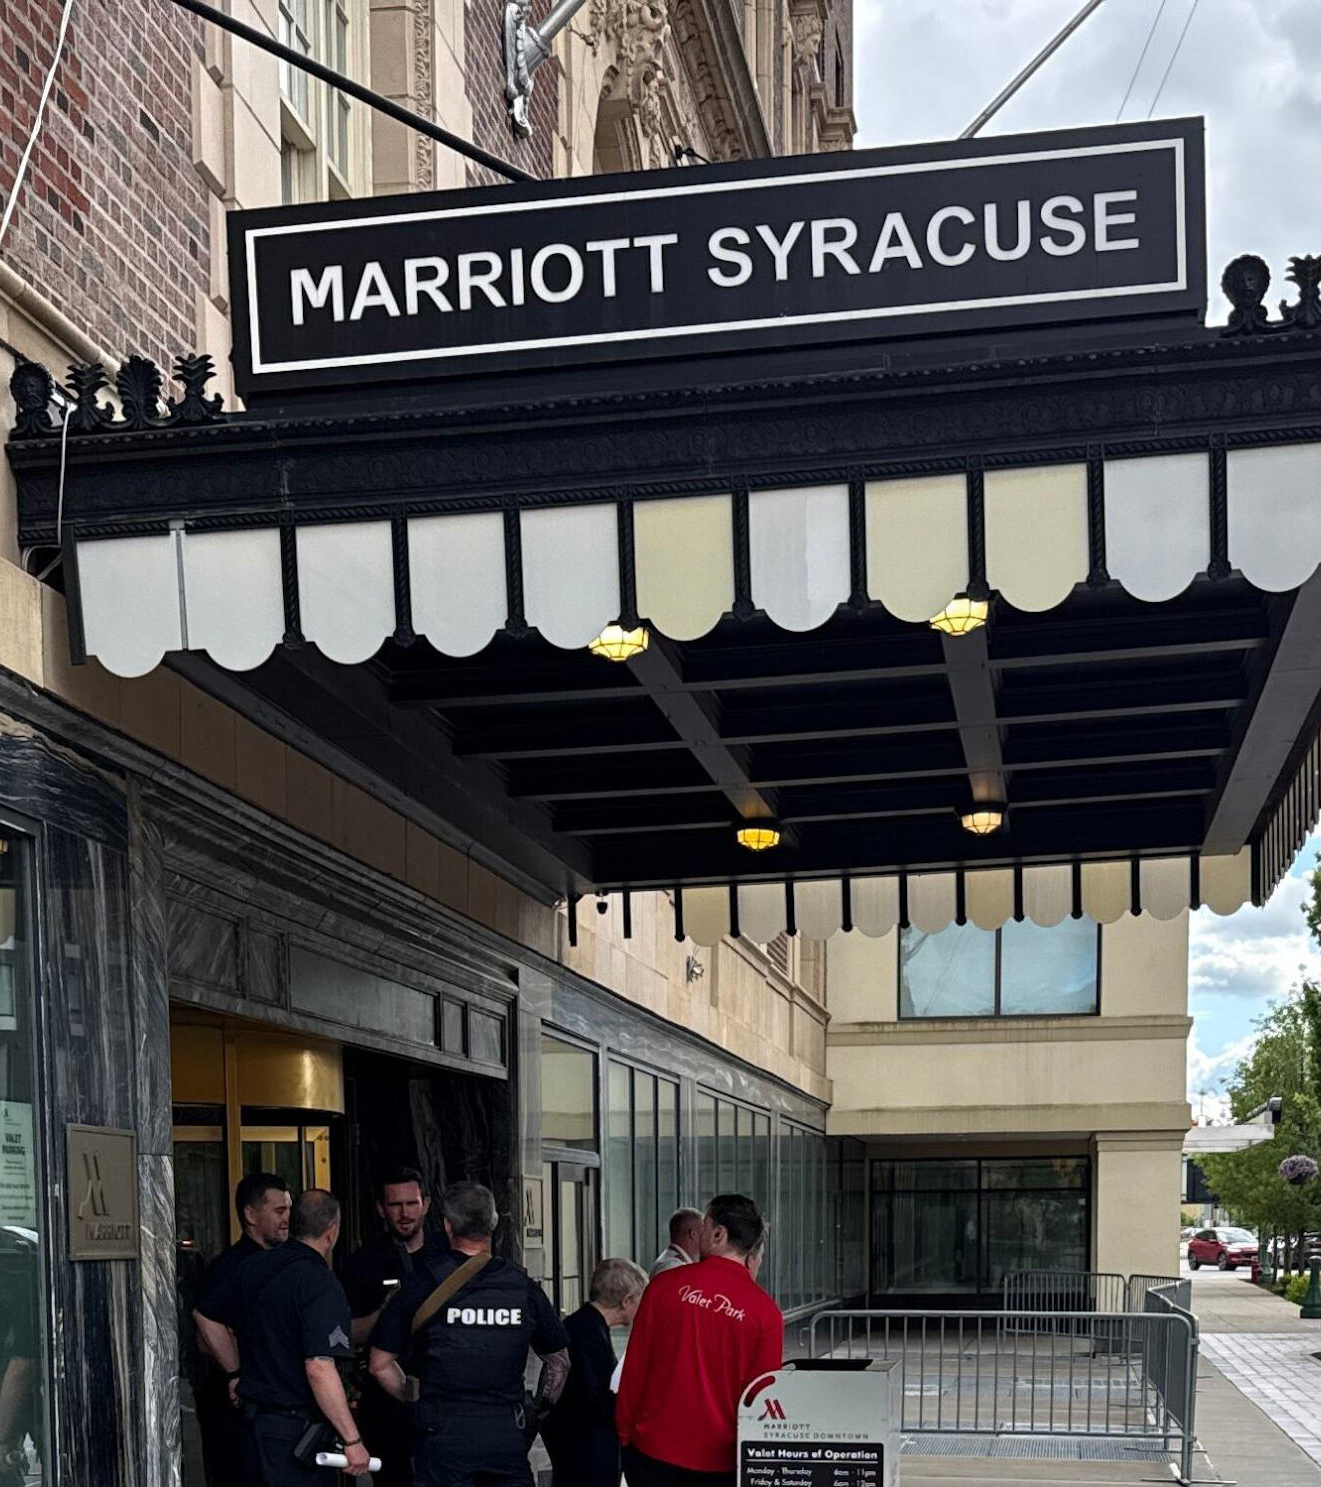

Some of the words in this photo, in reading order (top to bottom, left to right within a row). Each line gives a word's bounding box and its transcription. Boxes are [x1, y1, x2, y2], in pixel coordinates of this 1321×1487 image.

[290, 234, 679, 325] MARRIOTT
[706, 190, 1142, 288] SYRACUSE
[678, 1285, 712, 1308] Valet
[714, 1293, 746, 1322] Park
[447, 1307, 522, 1326] POLICE
[763, 1423, 811, 1431] MARRIOTT
[747, 1448, 775, 1458] Valet
[778, 1449, 809, 1458] Hours
[811, 1450, 822, 1458] of
[825, 1450, 878, 1460] Operation
[747, 1467, 775, 1476] Monday
[750, 1479, 772, 1487] Friday
